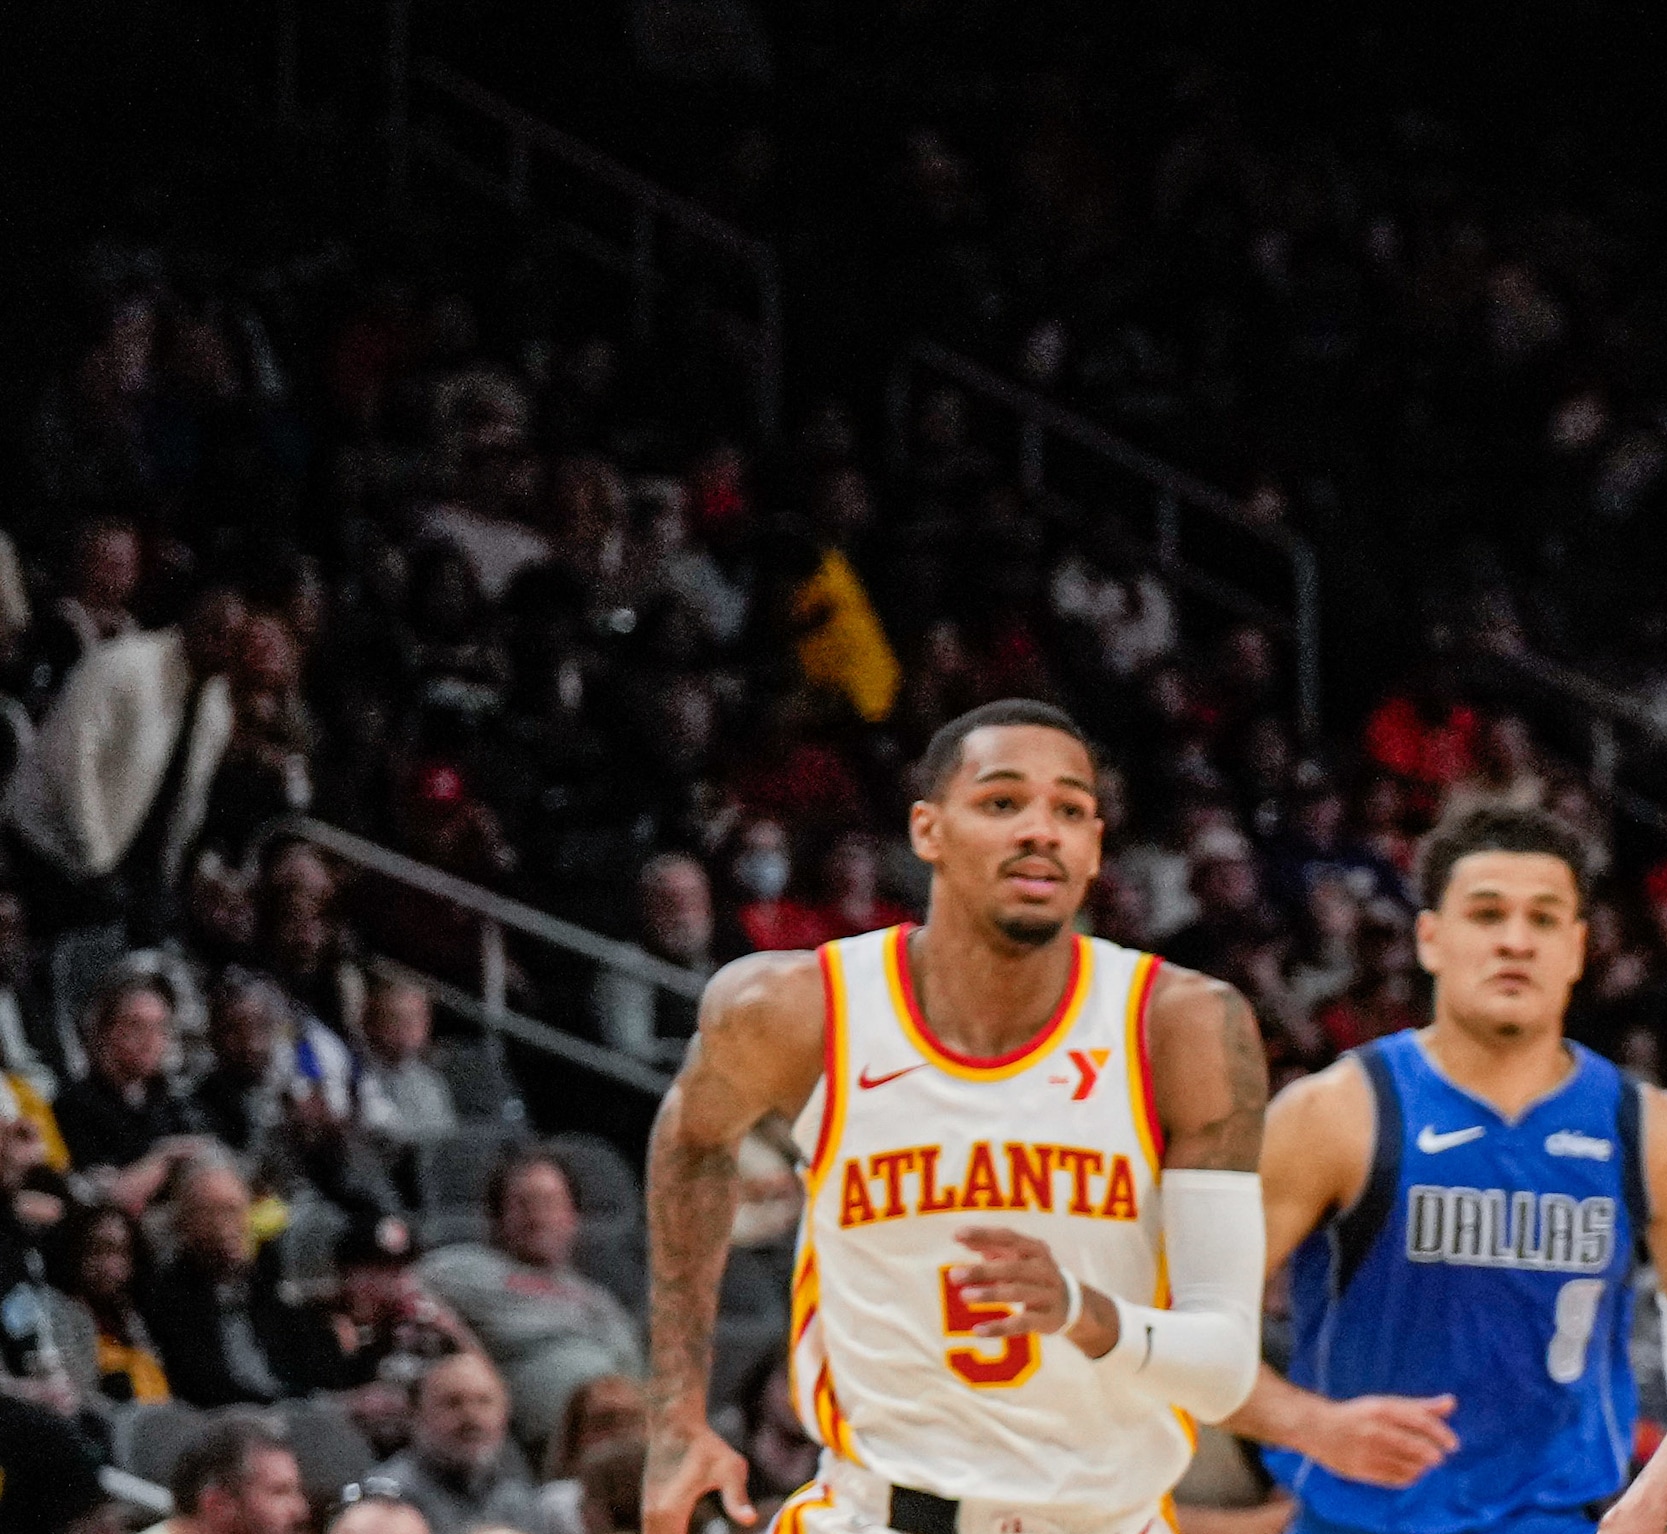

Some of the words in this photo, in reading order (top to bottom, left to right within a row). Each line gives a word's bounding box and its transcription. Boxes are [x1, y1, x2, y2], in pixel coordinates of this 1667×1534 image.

[838, 1139, 1140, 1231] ATLANTA
[1406, 1185, 1616, 1275] DALLAS
[938, 1264, 1042, 1389] 5
